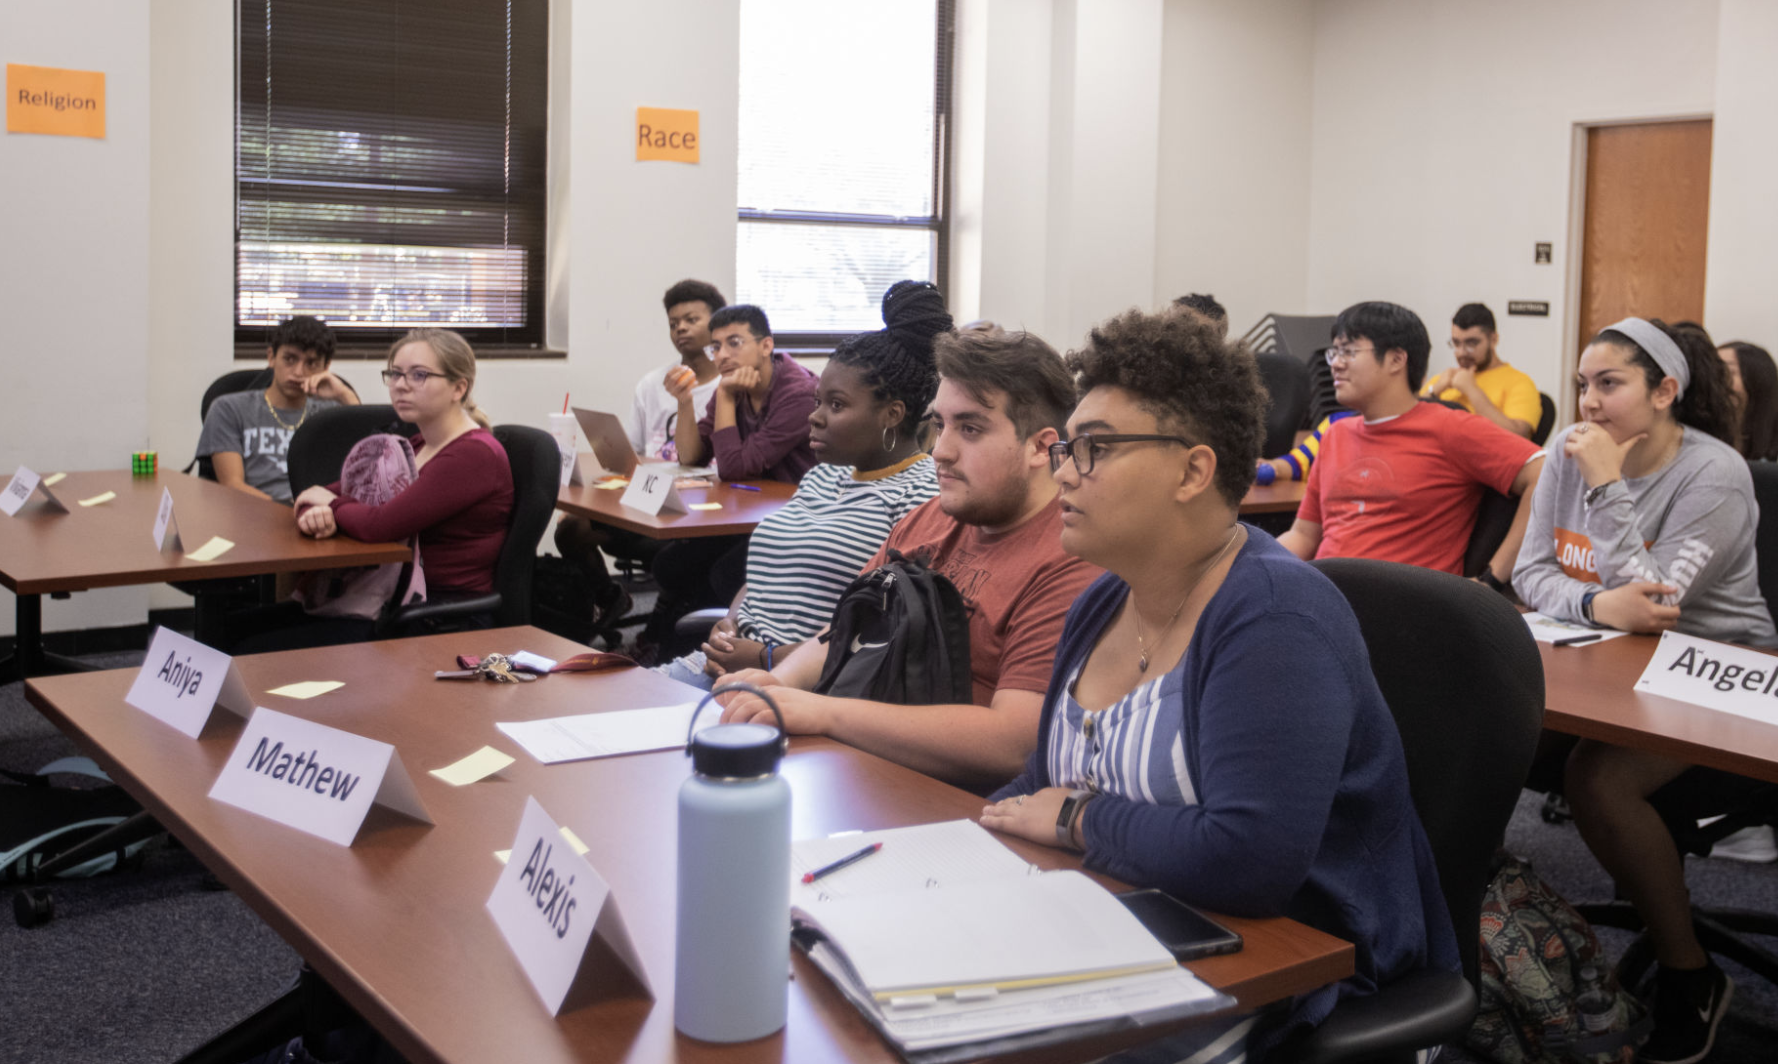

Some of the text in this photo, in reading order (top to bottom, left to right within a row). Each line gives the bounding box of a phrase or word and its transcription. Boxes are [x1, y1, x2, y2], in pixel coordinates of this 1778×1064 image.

[18, 88, 97, 113] Religion
[638, 123, 697, 151] Race
[243, 426, 295, 459] TEX
[1554, 538, 1597, 573] ONG
[157, 649, 204, 699] Aniya
[1667, 645, 1778, 699] Angel
[246, 736, 361, 802] Mathew
[519, 836, 577, 940] Alexis
